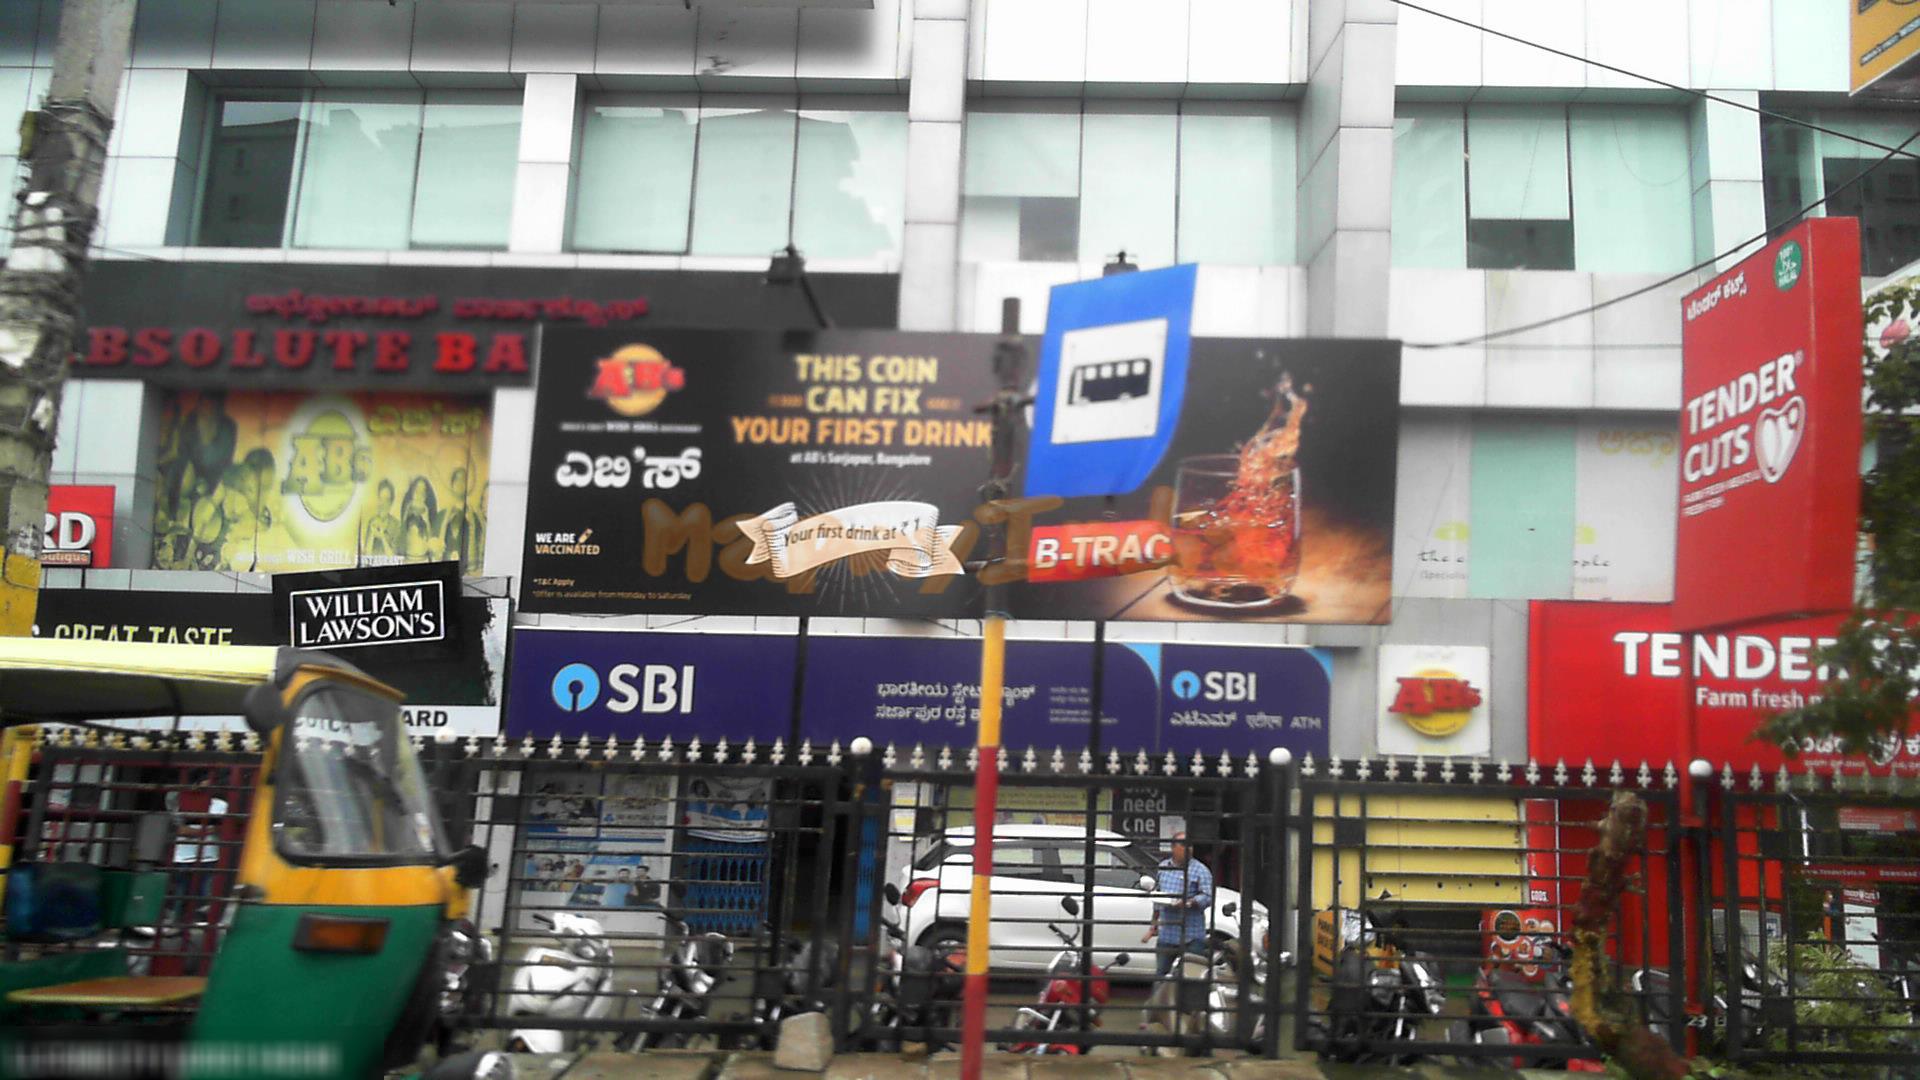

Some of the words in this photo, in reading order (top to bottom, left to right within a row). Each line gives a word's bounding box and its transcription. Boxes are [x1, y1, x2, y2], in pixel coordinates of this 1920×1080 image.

[70, 326, 410, 371] BSOLUTE
[795, 354, 861, 382] THIS
[868, 356, 938, 384] COIN
[806, 385, 867, 413] CAN
[873, 387, 922, 414] FIX
[731, 416, 810, 443] YOUR
[816, 418, 898, 445] FIRST
[903, 420, 993, 447] DRINK
[1684, 423, 1751, 482] CUTS
[535, 544, 601, 555] VACCINATED
[536, 533, 553, 544] WE
[554, 533, 576, 544] ARE
[783, 527, 814, 547] Your
[816, 523, 843, 540] first
[848, 523, 880, 541] drink
[882, 525, 897, 540] at
[1034, 533, 1171, 569] B-TRAC
[305, 588, 424, 619] WILLIAM
[300, 612, 436, 645] LAWSON'S
[606, 663, 696, 714] SBI
[1204, 671, 1257, 702] SBI
[1696, 686, 1748, 708] Farm
[1751, 687, 1804, 710] fresh
[1289, 715, 1323, 729] ATM
[1123, 796, 1167, 813] need
